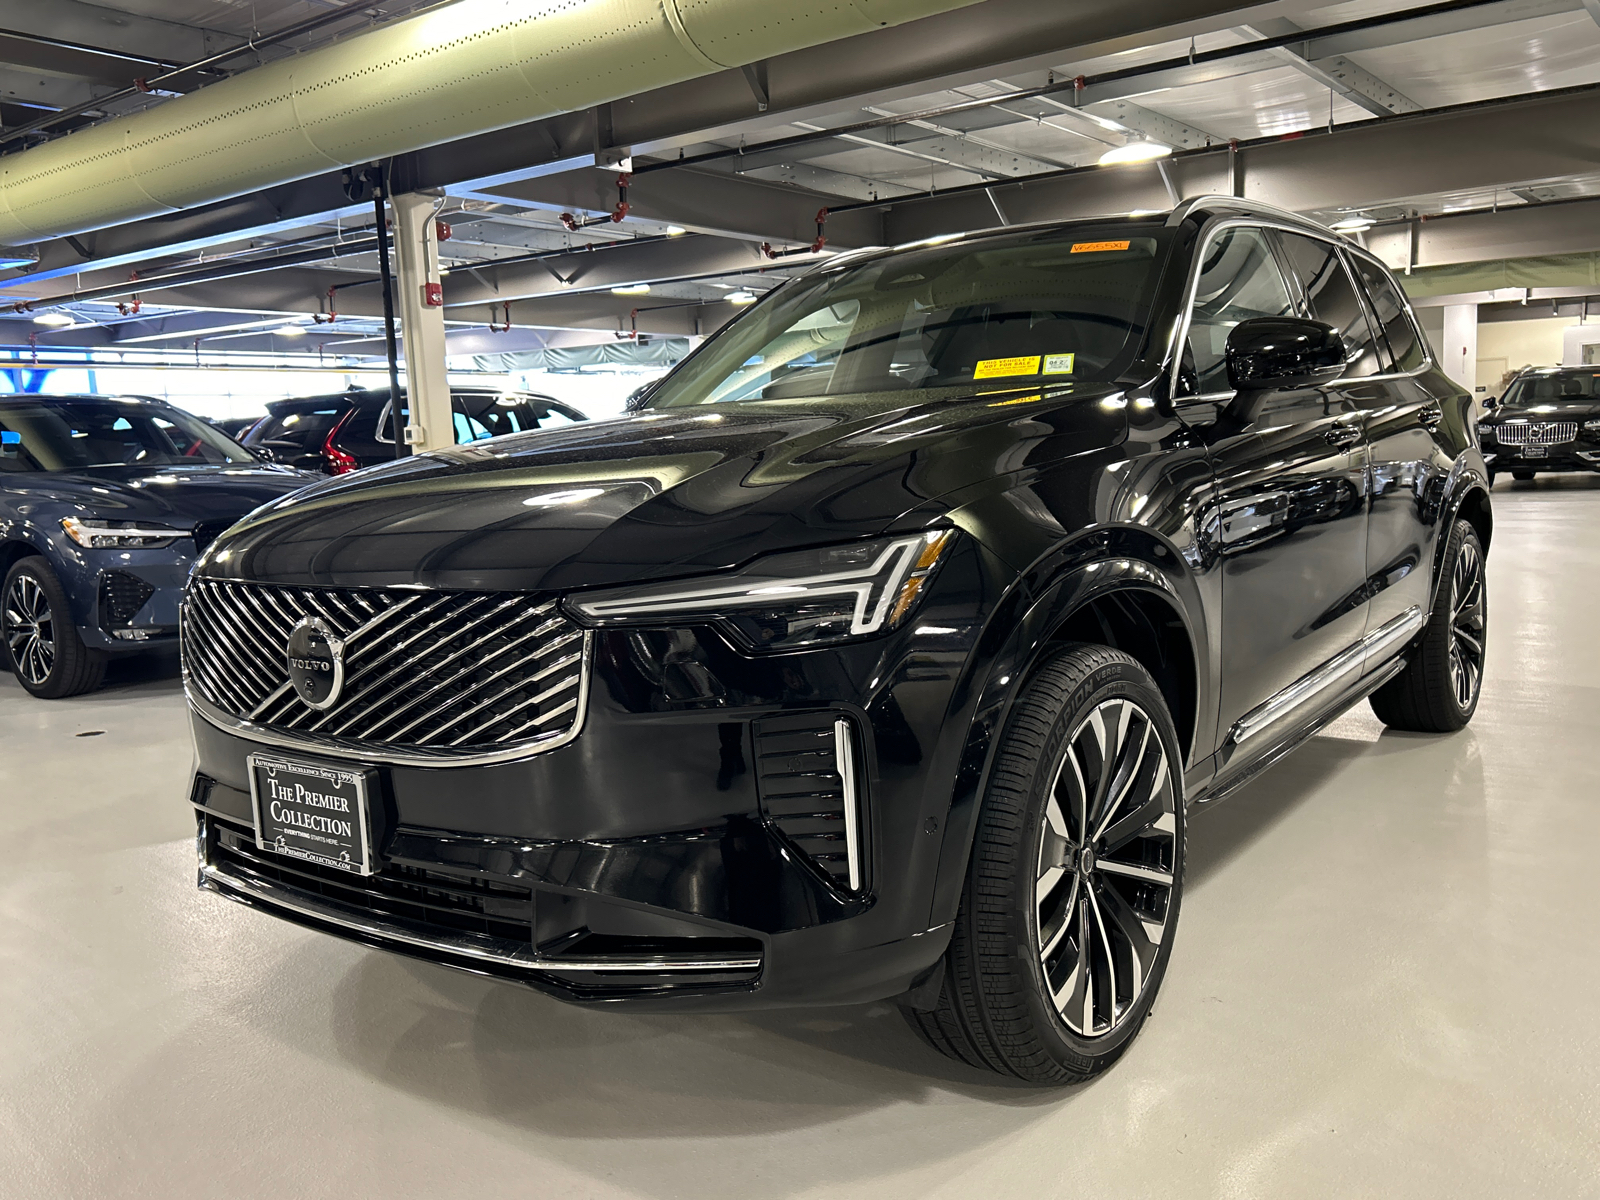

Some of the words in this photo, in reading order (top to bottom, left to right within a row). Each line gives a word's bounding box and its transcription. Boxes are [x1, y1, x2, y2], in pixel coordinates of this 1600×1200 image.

[290, 658, 330, 671] VOLVO
[1095, 666, 1122, 681] VERDE
[338, 773, 353, 782] 1995
[267, 778, 294, 802] THE
[294, 783, 350, 813] PREMIER
[270, 801, 352, 837] COLLECTION
